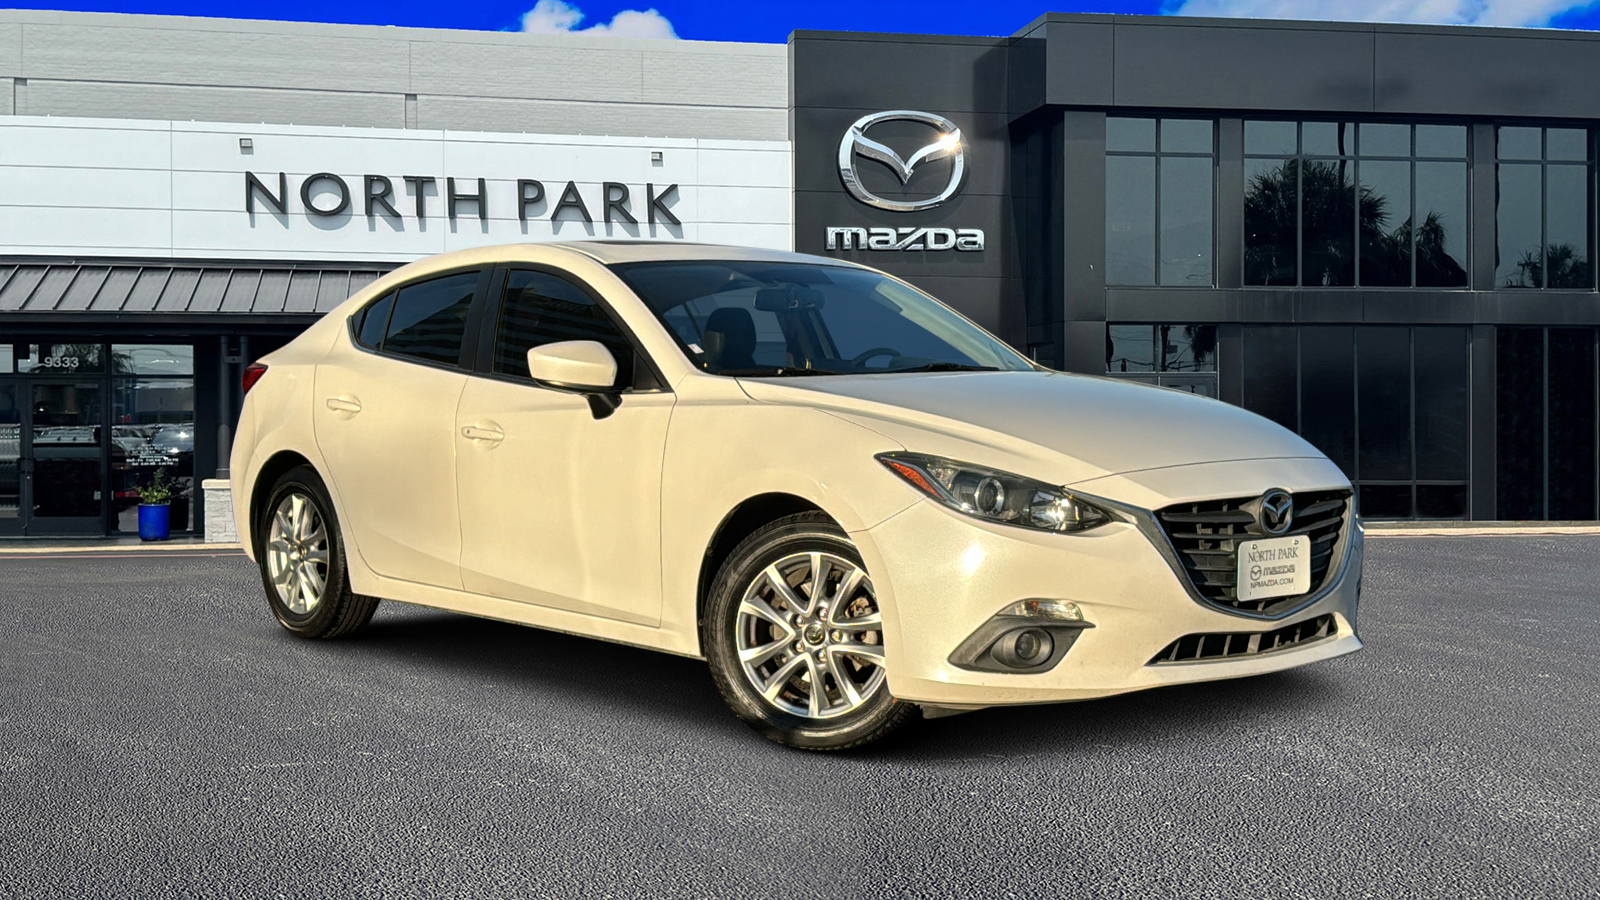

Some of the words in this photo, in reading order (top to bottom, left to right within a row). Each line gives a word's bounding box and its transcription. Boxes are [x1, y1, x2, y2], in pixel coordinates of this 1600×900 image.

[245, 170, 487, 221] NORTH
[517, 178, 682, 226] PARK
[44, 356, 79, 368] 9333
[1248, 549, 1276, 563] NORTH
[1278, 547, 1298, 559] PARK
[1250, 577, 1293, 588] NPMAZDA.COM
